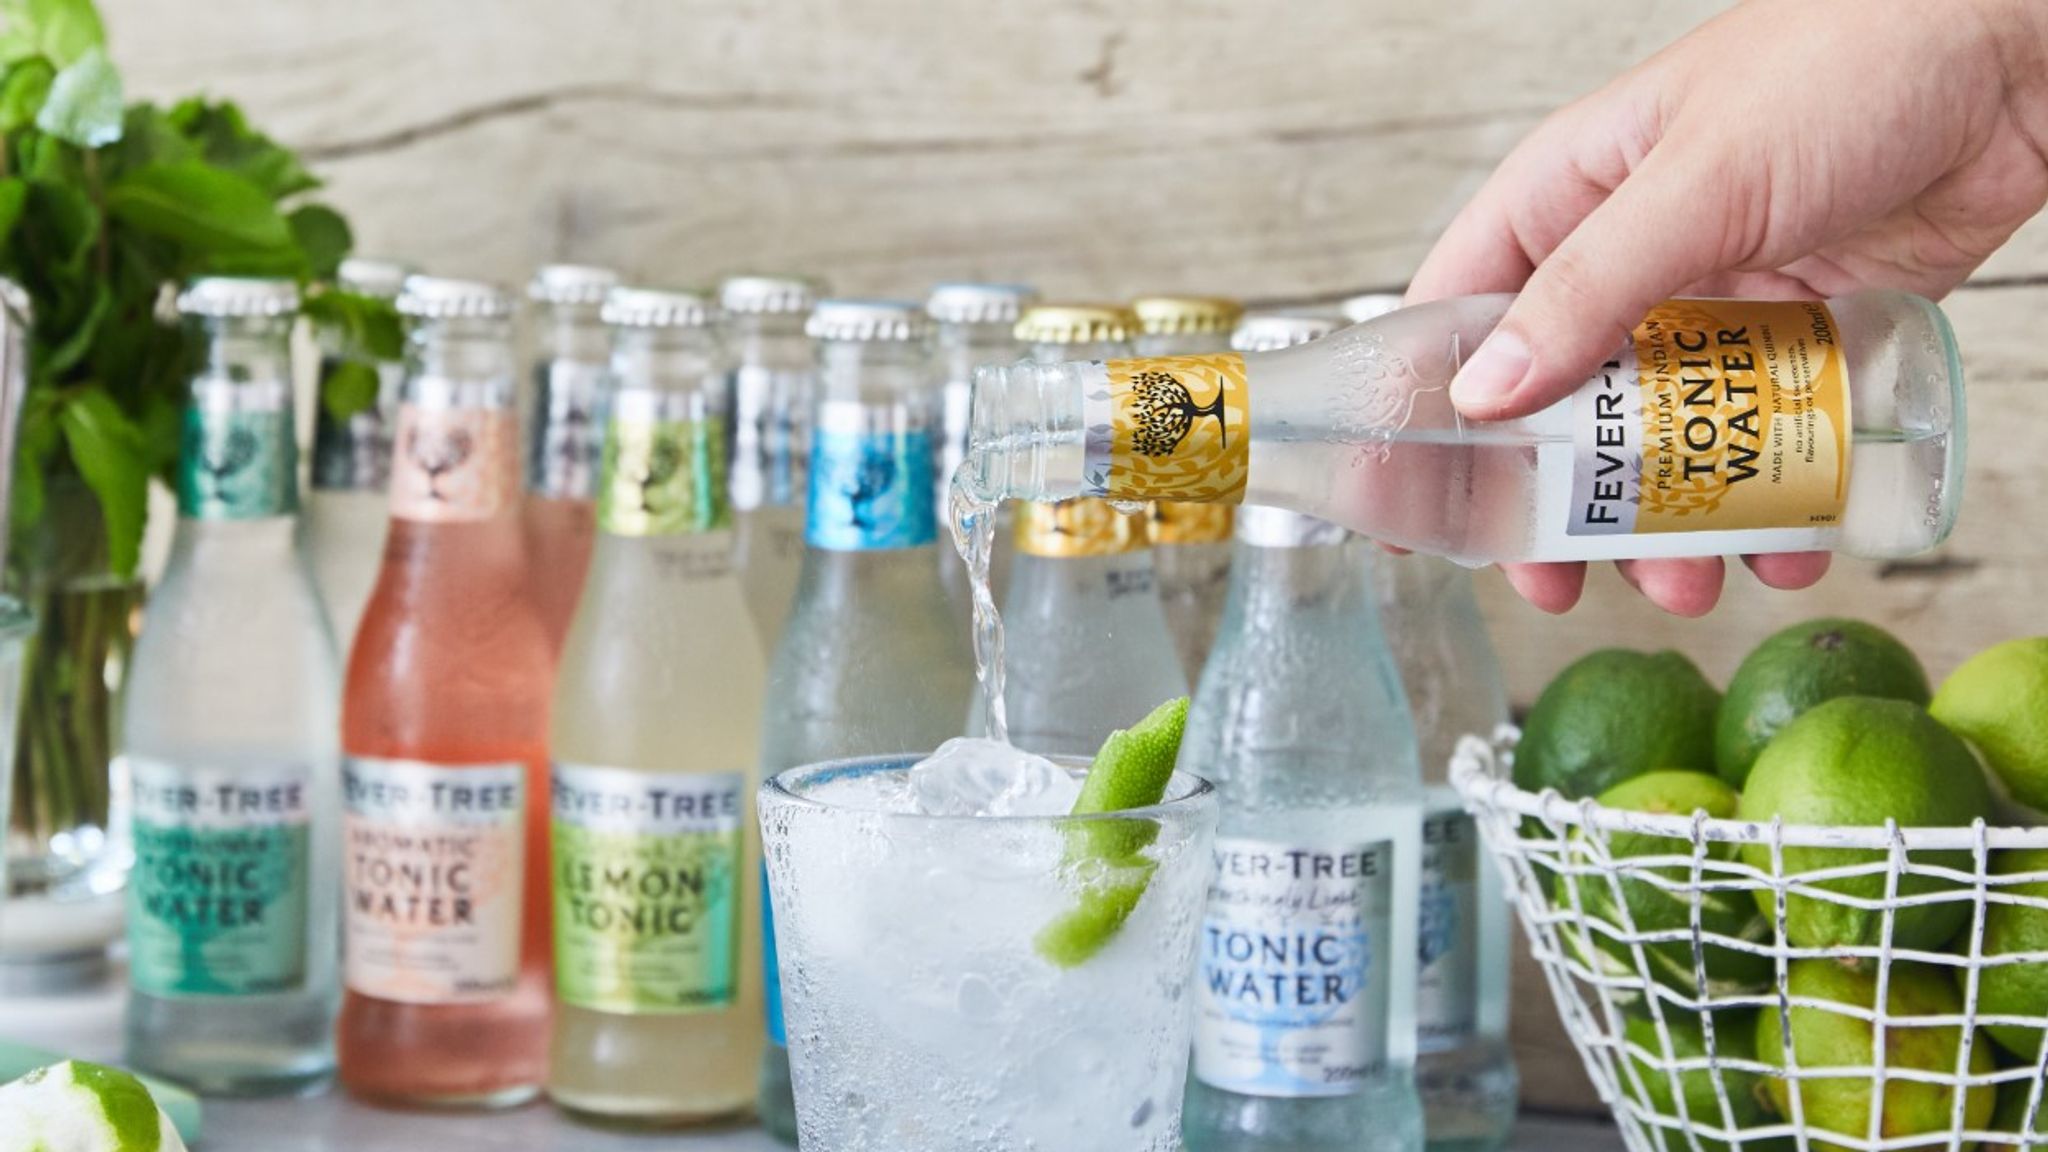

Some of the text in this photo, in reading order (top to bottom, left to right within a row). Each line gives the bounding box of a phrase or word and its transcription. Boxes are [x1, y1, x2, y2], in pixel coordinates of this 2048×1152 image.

[1646, 321, 1674, 490] PREMIUM INDIAN
[1673, 330, 1718, 482] TONIC
[1716, 325, 1761, 486] WATER
[1770, 364, 1783, 414] NATURAL
[1773, 417, 1784, 448] WITH
[1771, 450, 1784, 484] MADE
[144, 854, 259, 892] TONIC
[354, 854, 471, 894] TONIC
[561, 861, 706, 900] LEMON
[146, 894, 265, 928] WATER
[354, 890, 474, 926] WATER
[570, 896, 694, 936] TONIC
[1207, 928, 1343, 969] TONIC
[1207, 964, 1350, 1006] WATER
